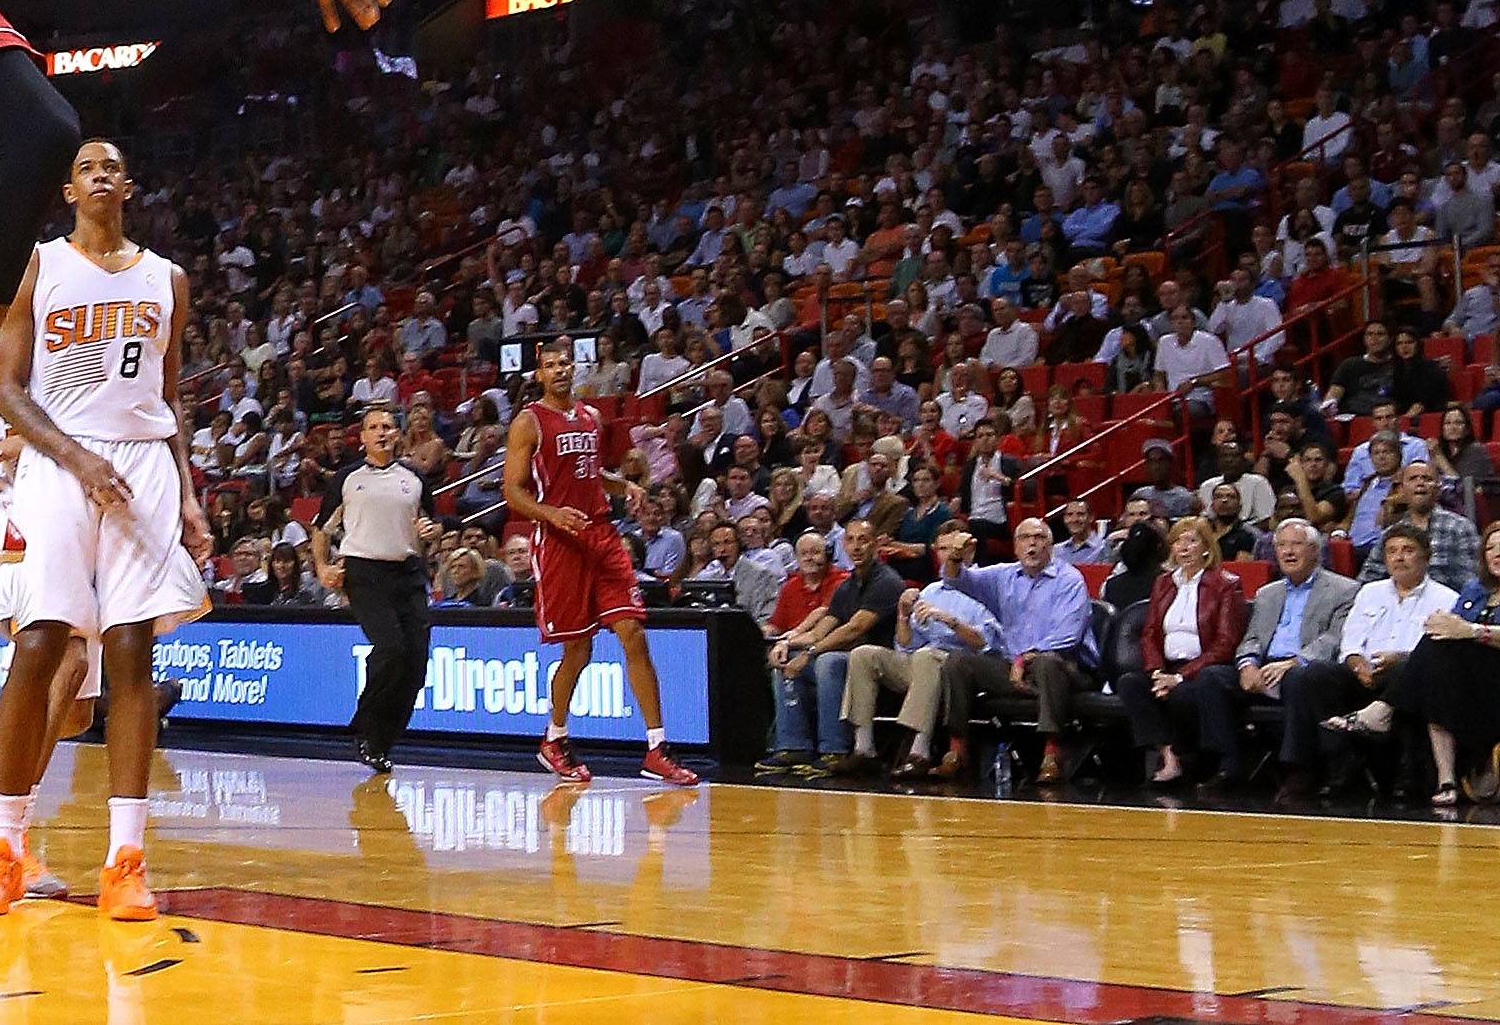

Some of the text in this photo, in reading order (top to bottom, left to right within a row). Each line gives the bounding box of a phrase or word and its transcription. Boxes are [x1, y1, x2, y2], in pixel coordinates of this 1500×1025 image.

[120, 340, 142, 379] 8
[152, 638, 284, 673] aptops, Tablets
[212, 672, 269, 705] More!
